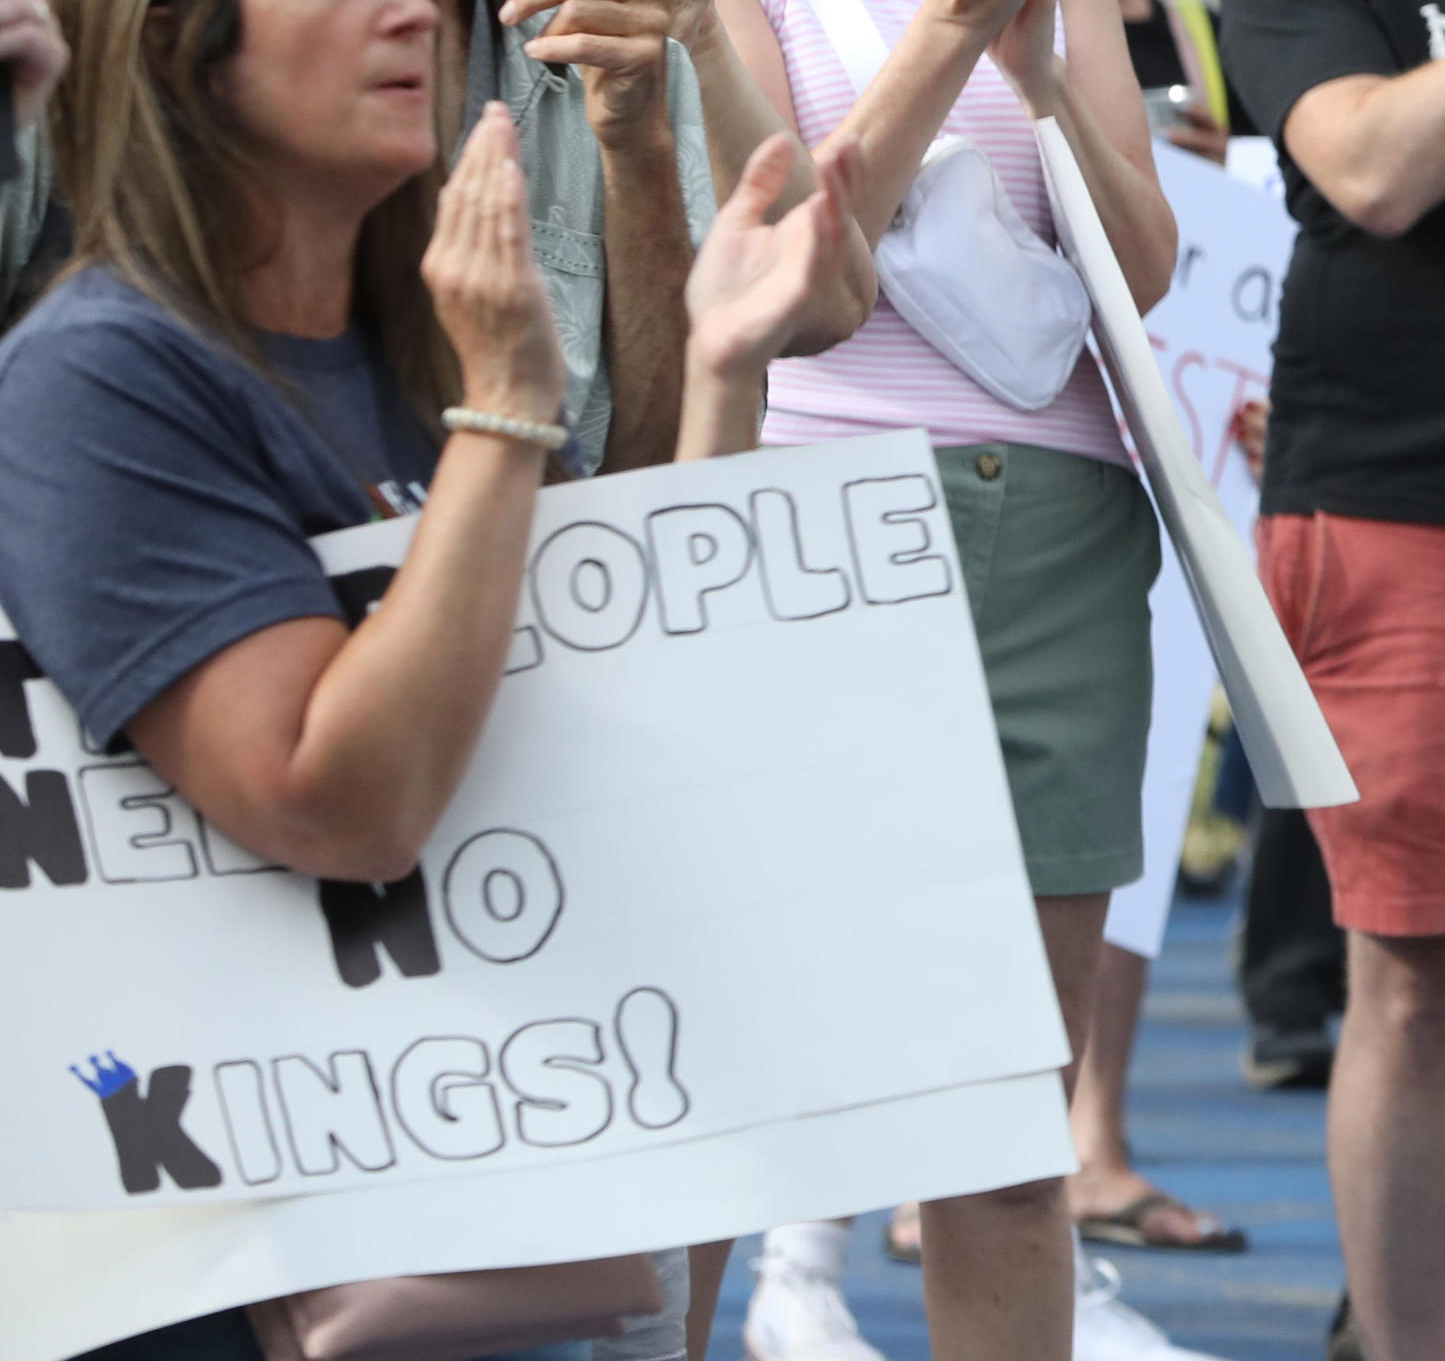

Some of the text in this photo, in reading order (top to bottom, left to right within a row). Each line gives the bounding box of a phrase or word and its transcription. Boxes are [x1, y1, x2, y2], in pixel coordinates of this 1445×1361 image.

[325, 473, 953, 676] OPLE
[318, 827, 565, 988] NO
[100, 986, 691, 1195] KINGS!
